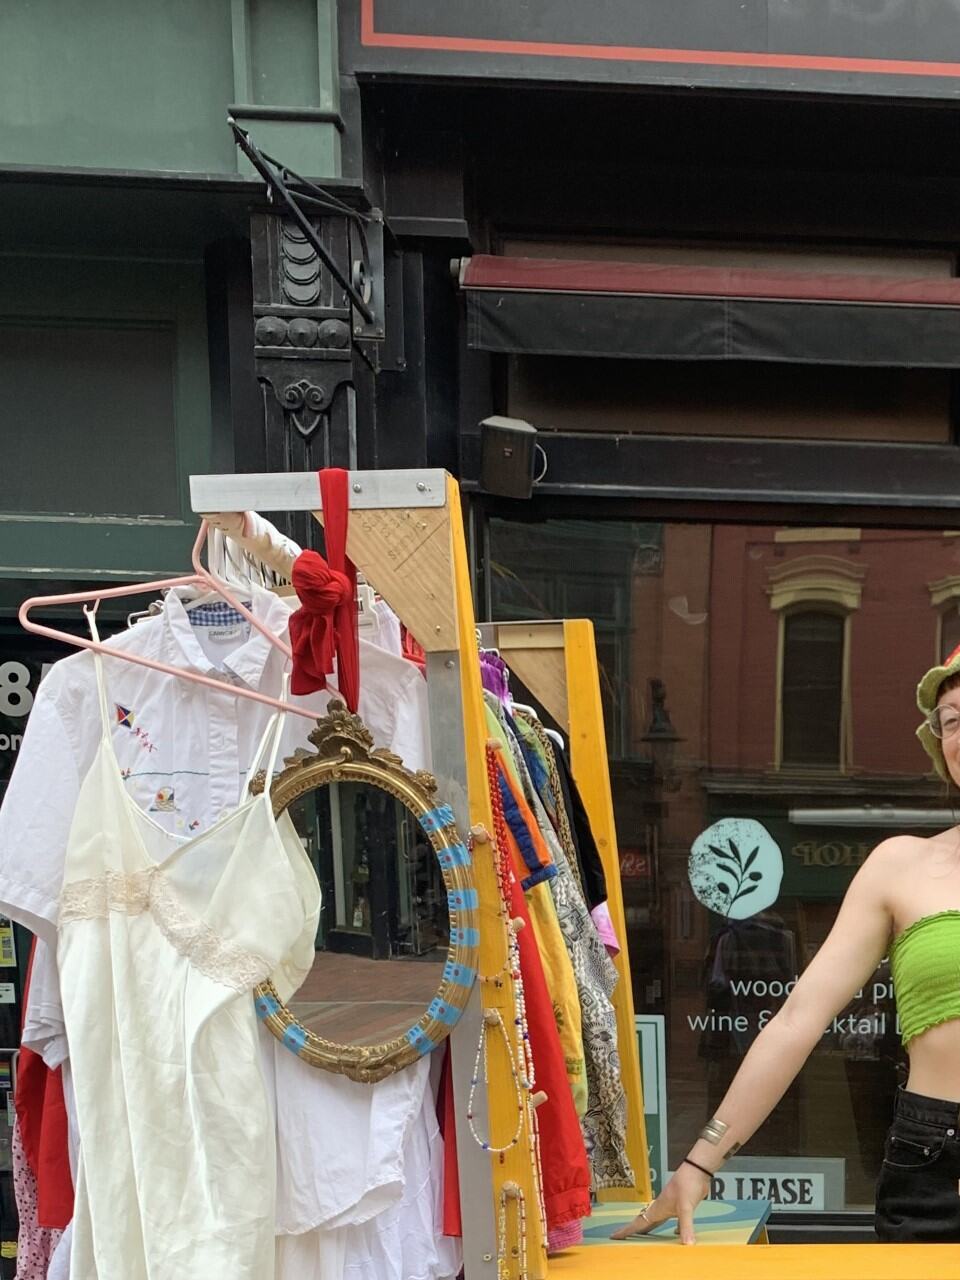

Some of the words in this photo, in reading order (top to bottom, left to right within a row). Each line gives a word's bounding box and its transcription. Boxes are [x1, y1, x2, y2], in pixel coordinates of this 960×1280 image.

[687, 1009, 749, 1032] wine
[825, 1012, 886, 1035] ktail
[735, 1178, 814, 1205] LEASE
